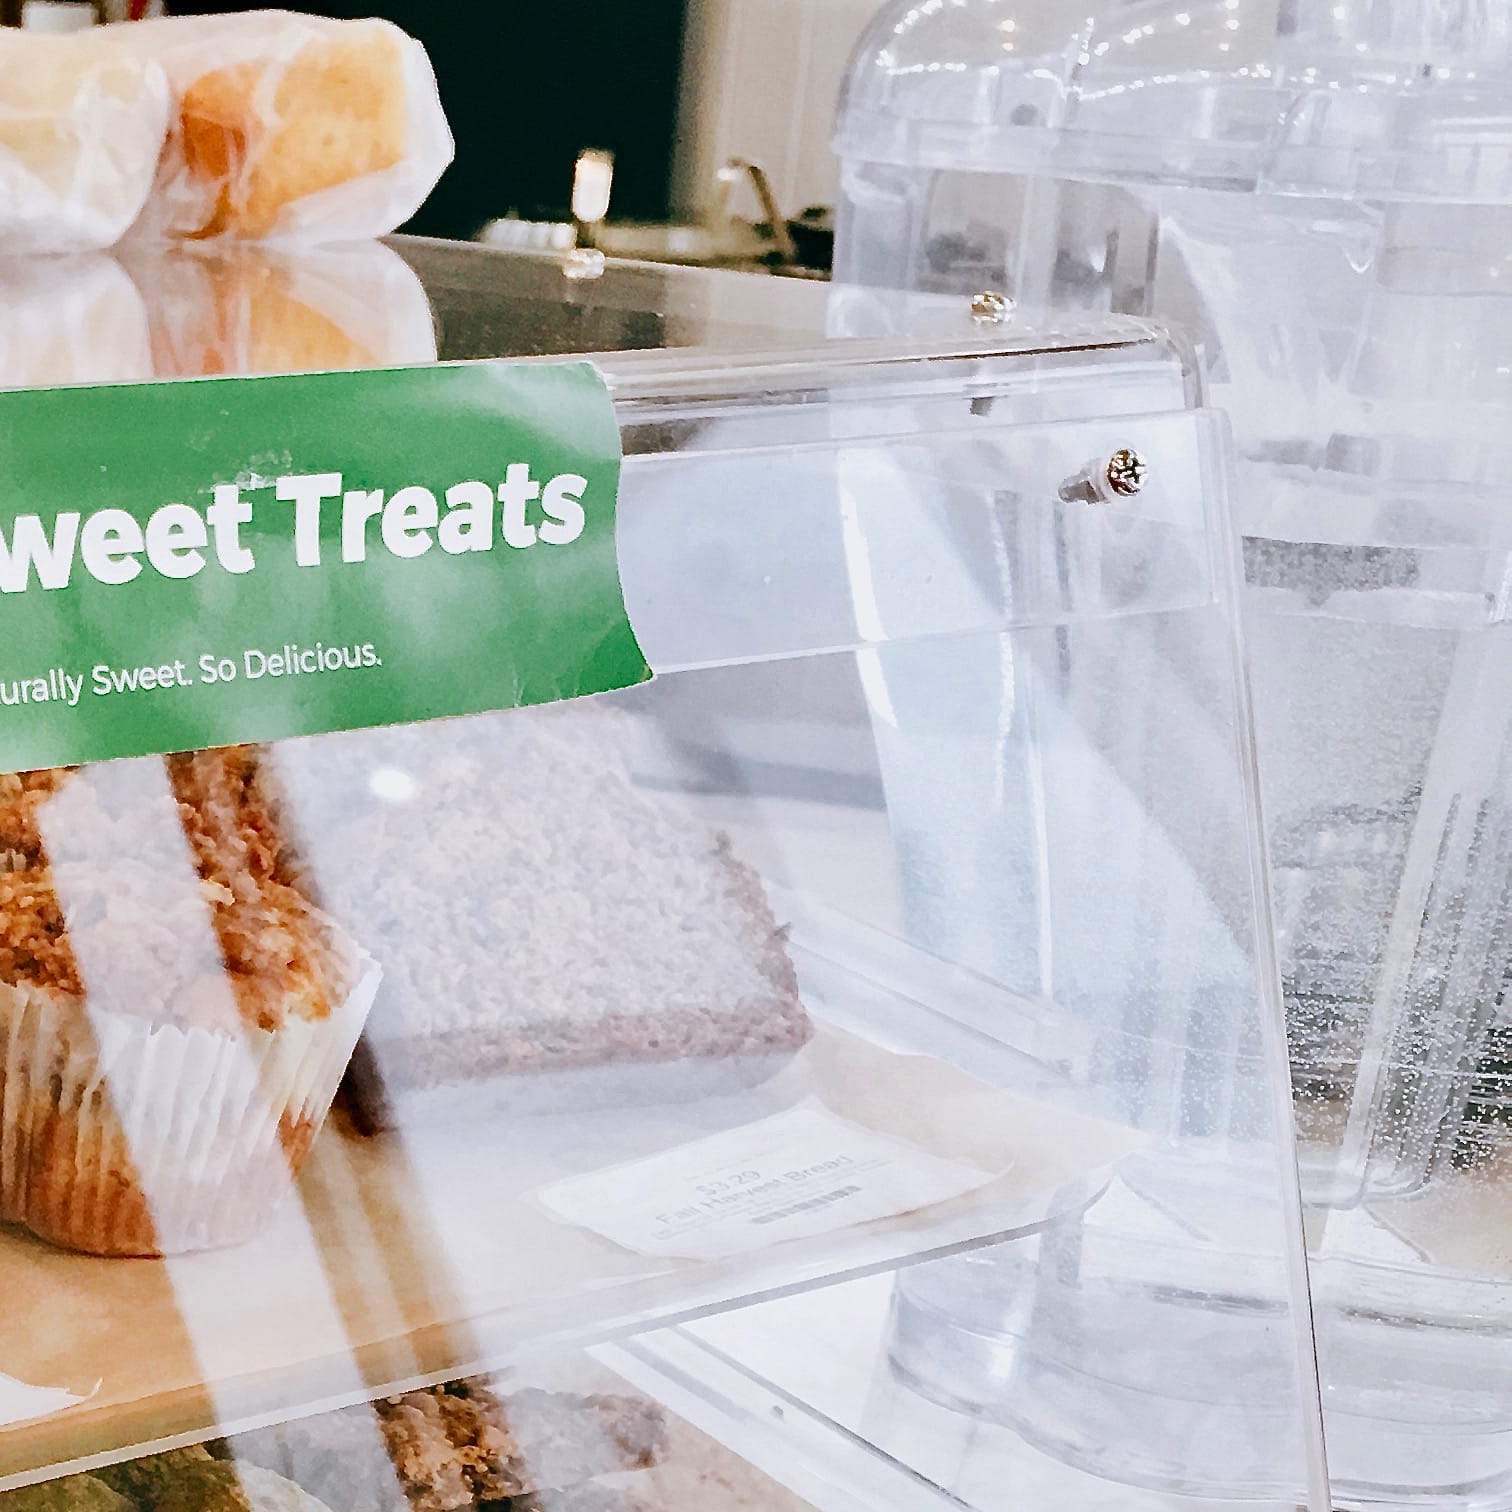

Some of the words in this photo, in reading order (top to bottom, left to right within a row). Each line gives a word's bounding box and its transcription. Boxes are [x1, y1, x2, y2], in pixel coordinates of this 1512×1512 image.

[278, 463, 587, 563] Treats
[92, 660, 192, 695] Sweet.
[198, 656, 236, 684] So
[245, 642, 381, 679] Delicious.
